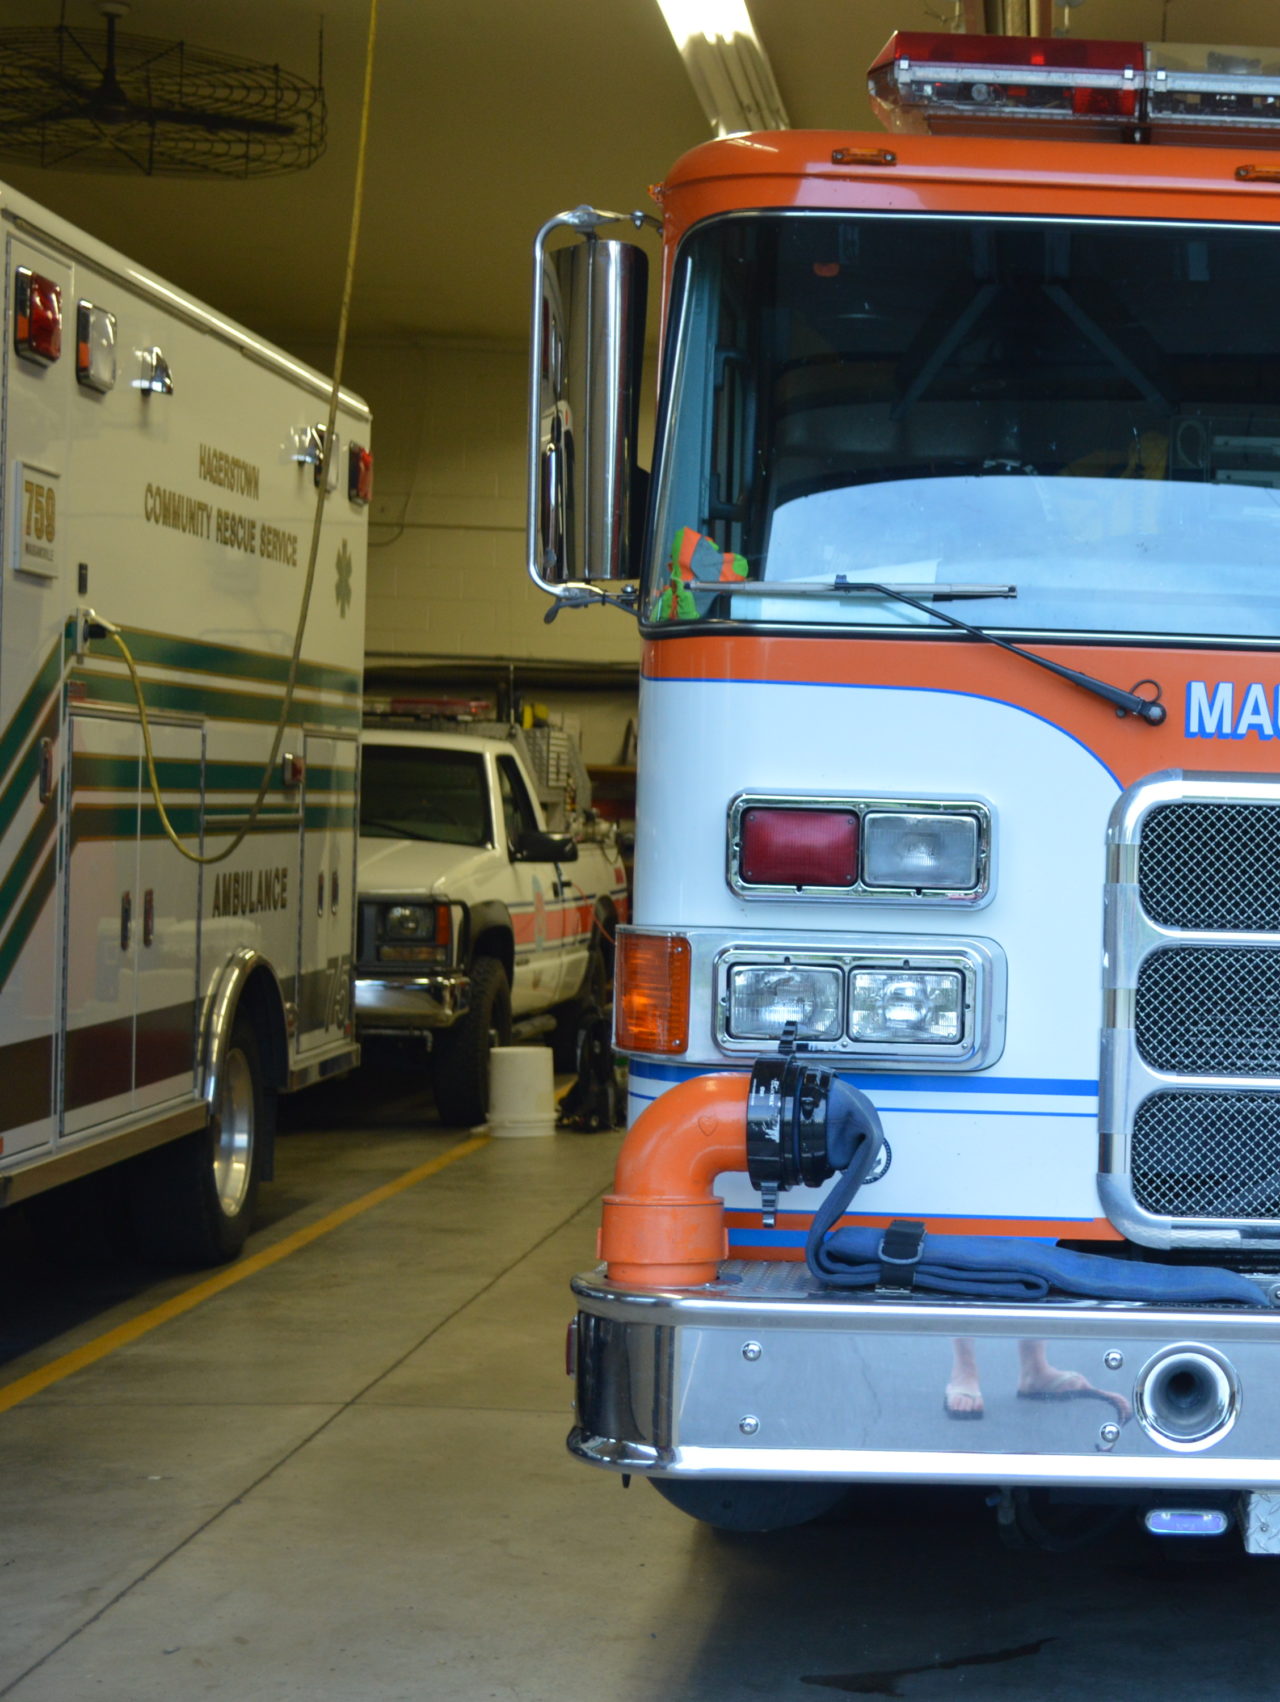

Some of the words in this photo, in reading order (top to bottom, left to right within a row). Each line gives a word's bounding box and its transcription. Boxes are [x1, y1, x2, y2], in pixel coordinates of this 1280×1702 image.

[199, 443, 260, 501] HAGERSTOWN
[144, 482, 213, 540] COMMUNITY
[215, 507, 256, 555] RESCUE
[259, 522, 298, 568] SERVICE
[211, 867, 288, 918] AMBULANCE
